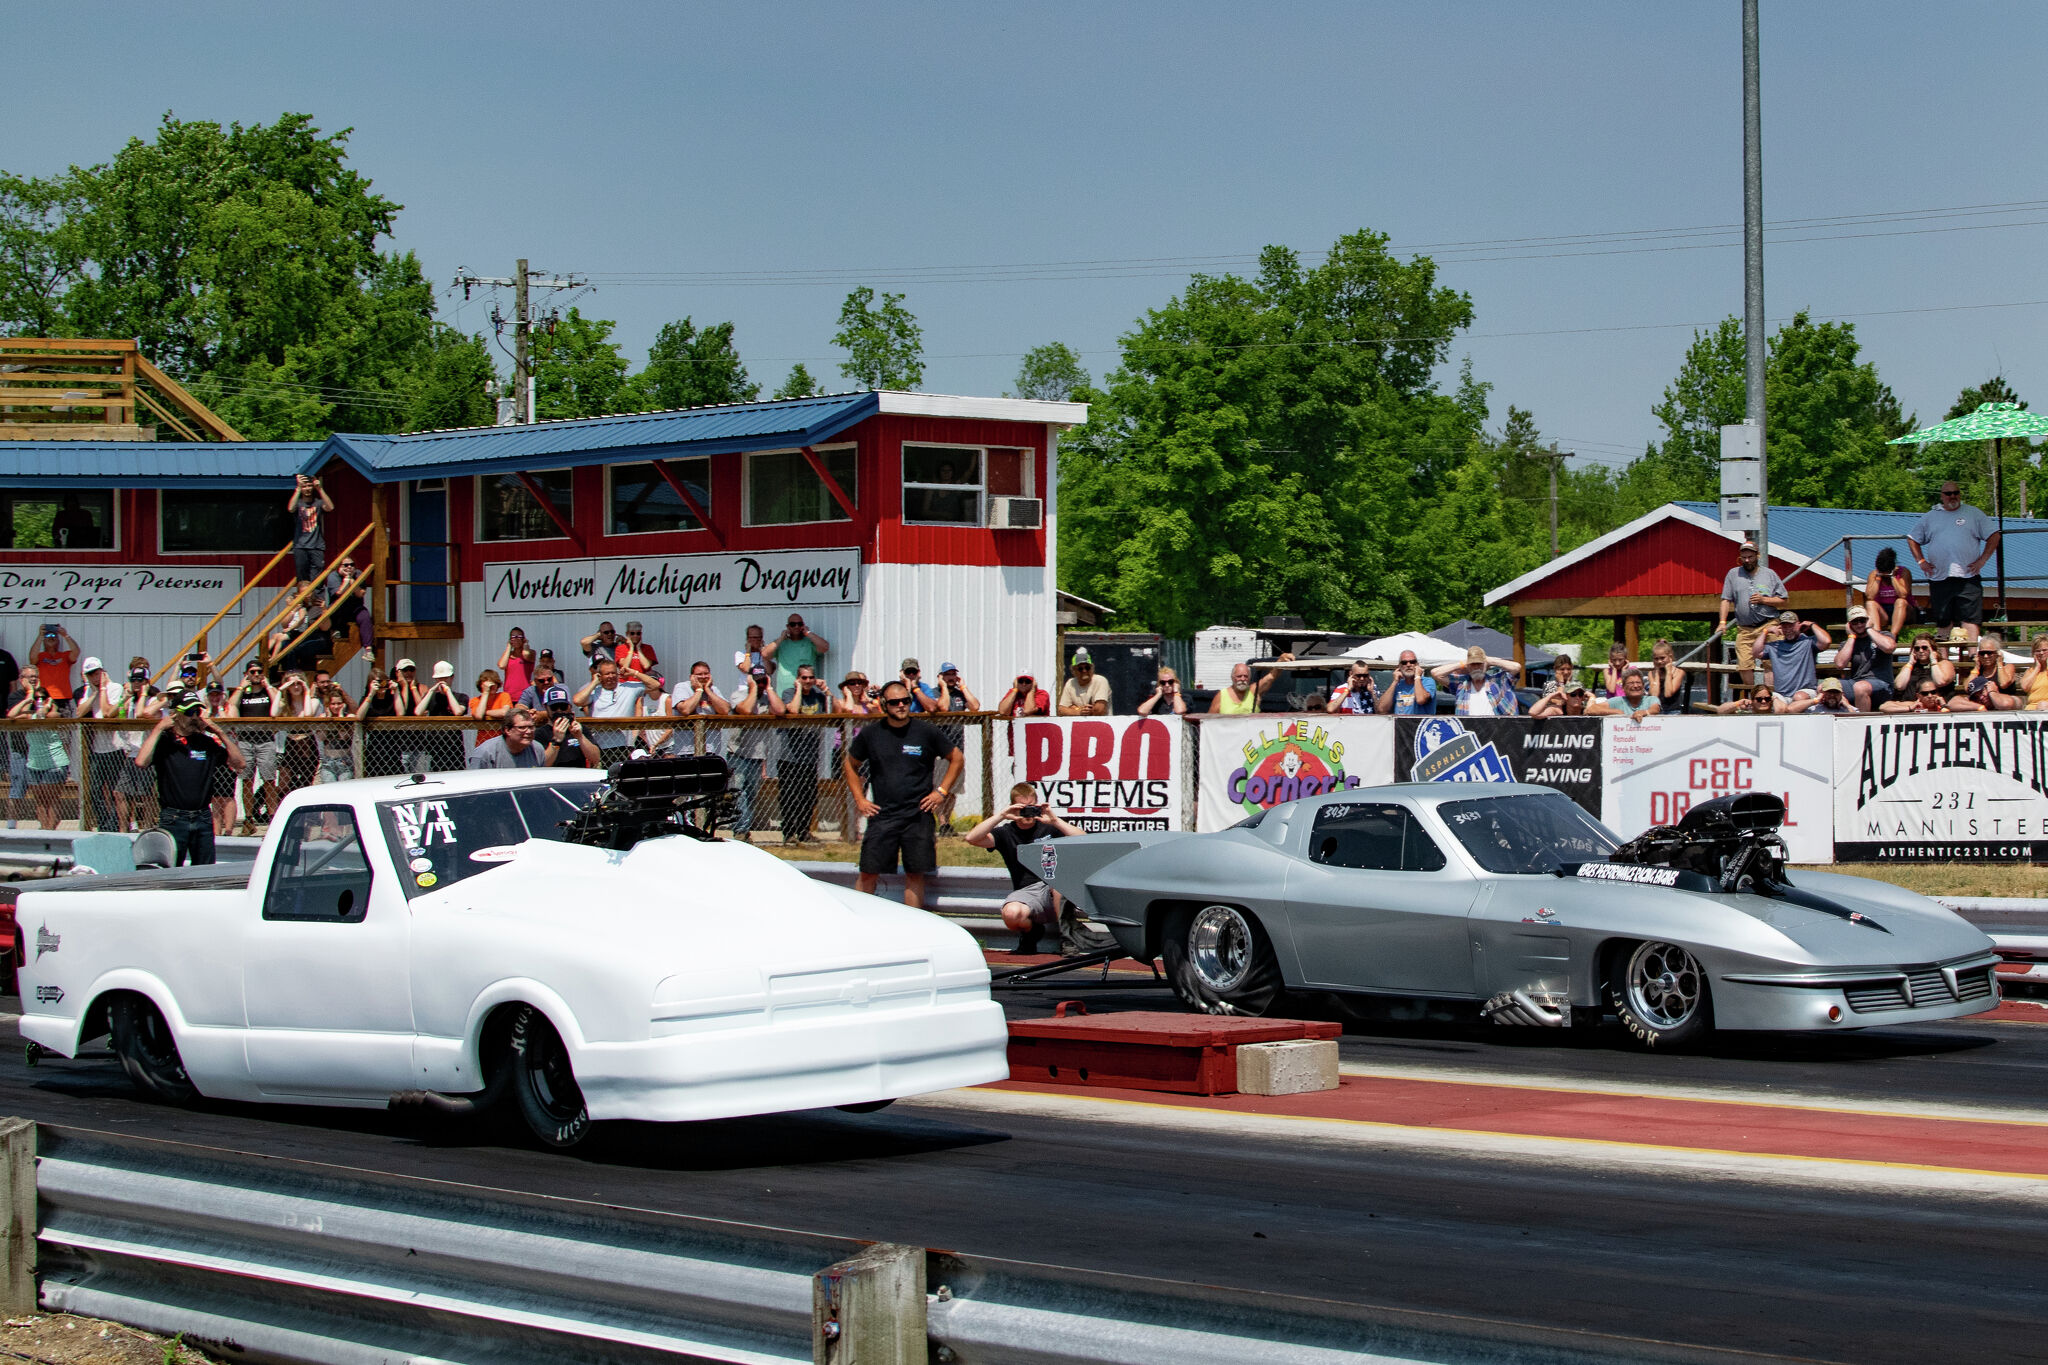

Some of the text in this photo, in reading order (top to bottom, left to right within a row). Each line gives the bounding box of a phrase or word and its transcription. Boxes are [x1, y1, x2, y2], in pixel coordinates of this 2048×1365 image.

[0, 572, 46, 588] Dan
[134, 571, 224, 591] Petersen
[491, 557, 852, 605] Northern Michigan Dragway
[1024, 718, 1171, 782] PRO
[1242, 719, 1345, 765] ELLENS
[1523, 734, 1595, 749] MILLING
[1424, 745, 1467, 777] ASPHALT
[1545, 753, 1573, 763] AND
[1525, 767, 1592, 783] PAVING
[1689, 758, 1753, 790] C&C
[391, 800, 450, 827] N/T
[1932, 792, 1975, 810] 231
[400, 820, 457, 849] P/T
[1878, 847, 2033, 857] AUTHENTIC231.COM
